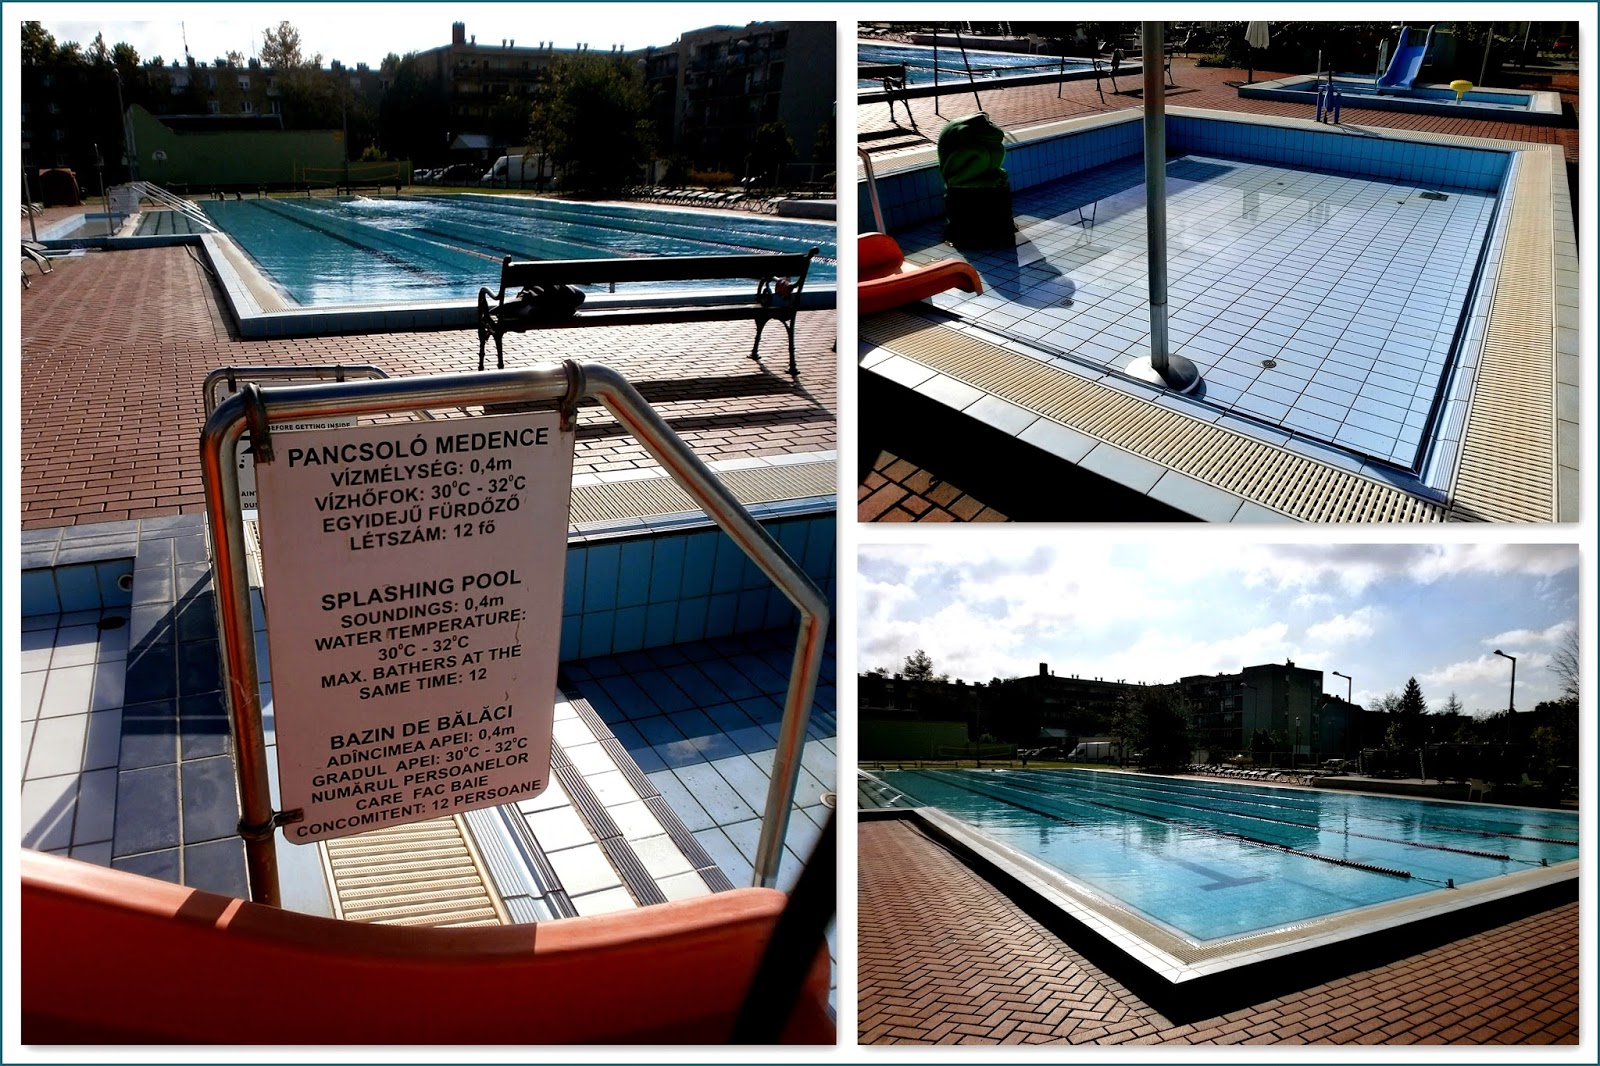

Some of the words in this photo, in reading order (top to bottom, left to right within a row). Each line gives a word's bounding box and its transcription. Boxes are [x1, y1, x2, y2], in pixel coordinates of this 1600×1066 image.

[288, 434, 428, 468] PANCSOLÓ
[435, 427, 549, 455] MEDENCE
[331, 458, 464, 487] VÍZMÉLYSÉG:
[470, 456, 512, 475] 0,4m
[314, 485, 425, 512] VÍZHŐFOK:
[323, 508, 423, 533] EGYIDEJŰ
[428, 494, 520, 521] FÜRDŐZŐ
[350, 524, 447, 550] LÉTSZÁM:
[453, 522, 473, 538] 12
[478, 520, 496, 535] fő
[321, 579, 455, 611] SPLASHING
[462, 570, 521, 591] POOL
[315, 630, 382, 651] WATER
[388, 610, 526, 641] TEMPERATURE:
[341, 600, 458, 628] SOUNDINGS:
[464, 595, 504, 612] 0,4m
[321, 671, 367, 688] MAX.
[373, 656, 457, 680] BATHERS
[462, 651, 483, 666] AT
[488, 645, 521, 661] THE
[360, 681, 411, 700] SAME
[418, 673, 463, 690] TIME:
[469, 668, 487, 681] 12
[327, 740, 426, 768] ADÎNCIMEA
[429, 733, 472, 750] APEI:
[478, 725, 515, 741] 0,4m
[330, 726, 395, 750] BAZIN
[402, 720, 430, 737] DE
[437, 705, 513, 730] BĂLĂCI
[311, 780, 398, 803] NUMĂRUL
[404, 752, 529, 786] PERSOANELOR
[312, 765, 386, 787] GRADUL
[396, 756, 440, 772] APEI:
[296, 802, 426, 838] CONCOMITENT:
[432, 798, 449, 810] 12
[454, 779, 541, 806] PERSOANE
[356, 793, 403, 810] CARE
[413, 784, 445, 800] FAC
[451, 776, 488, 792] BAIE
